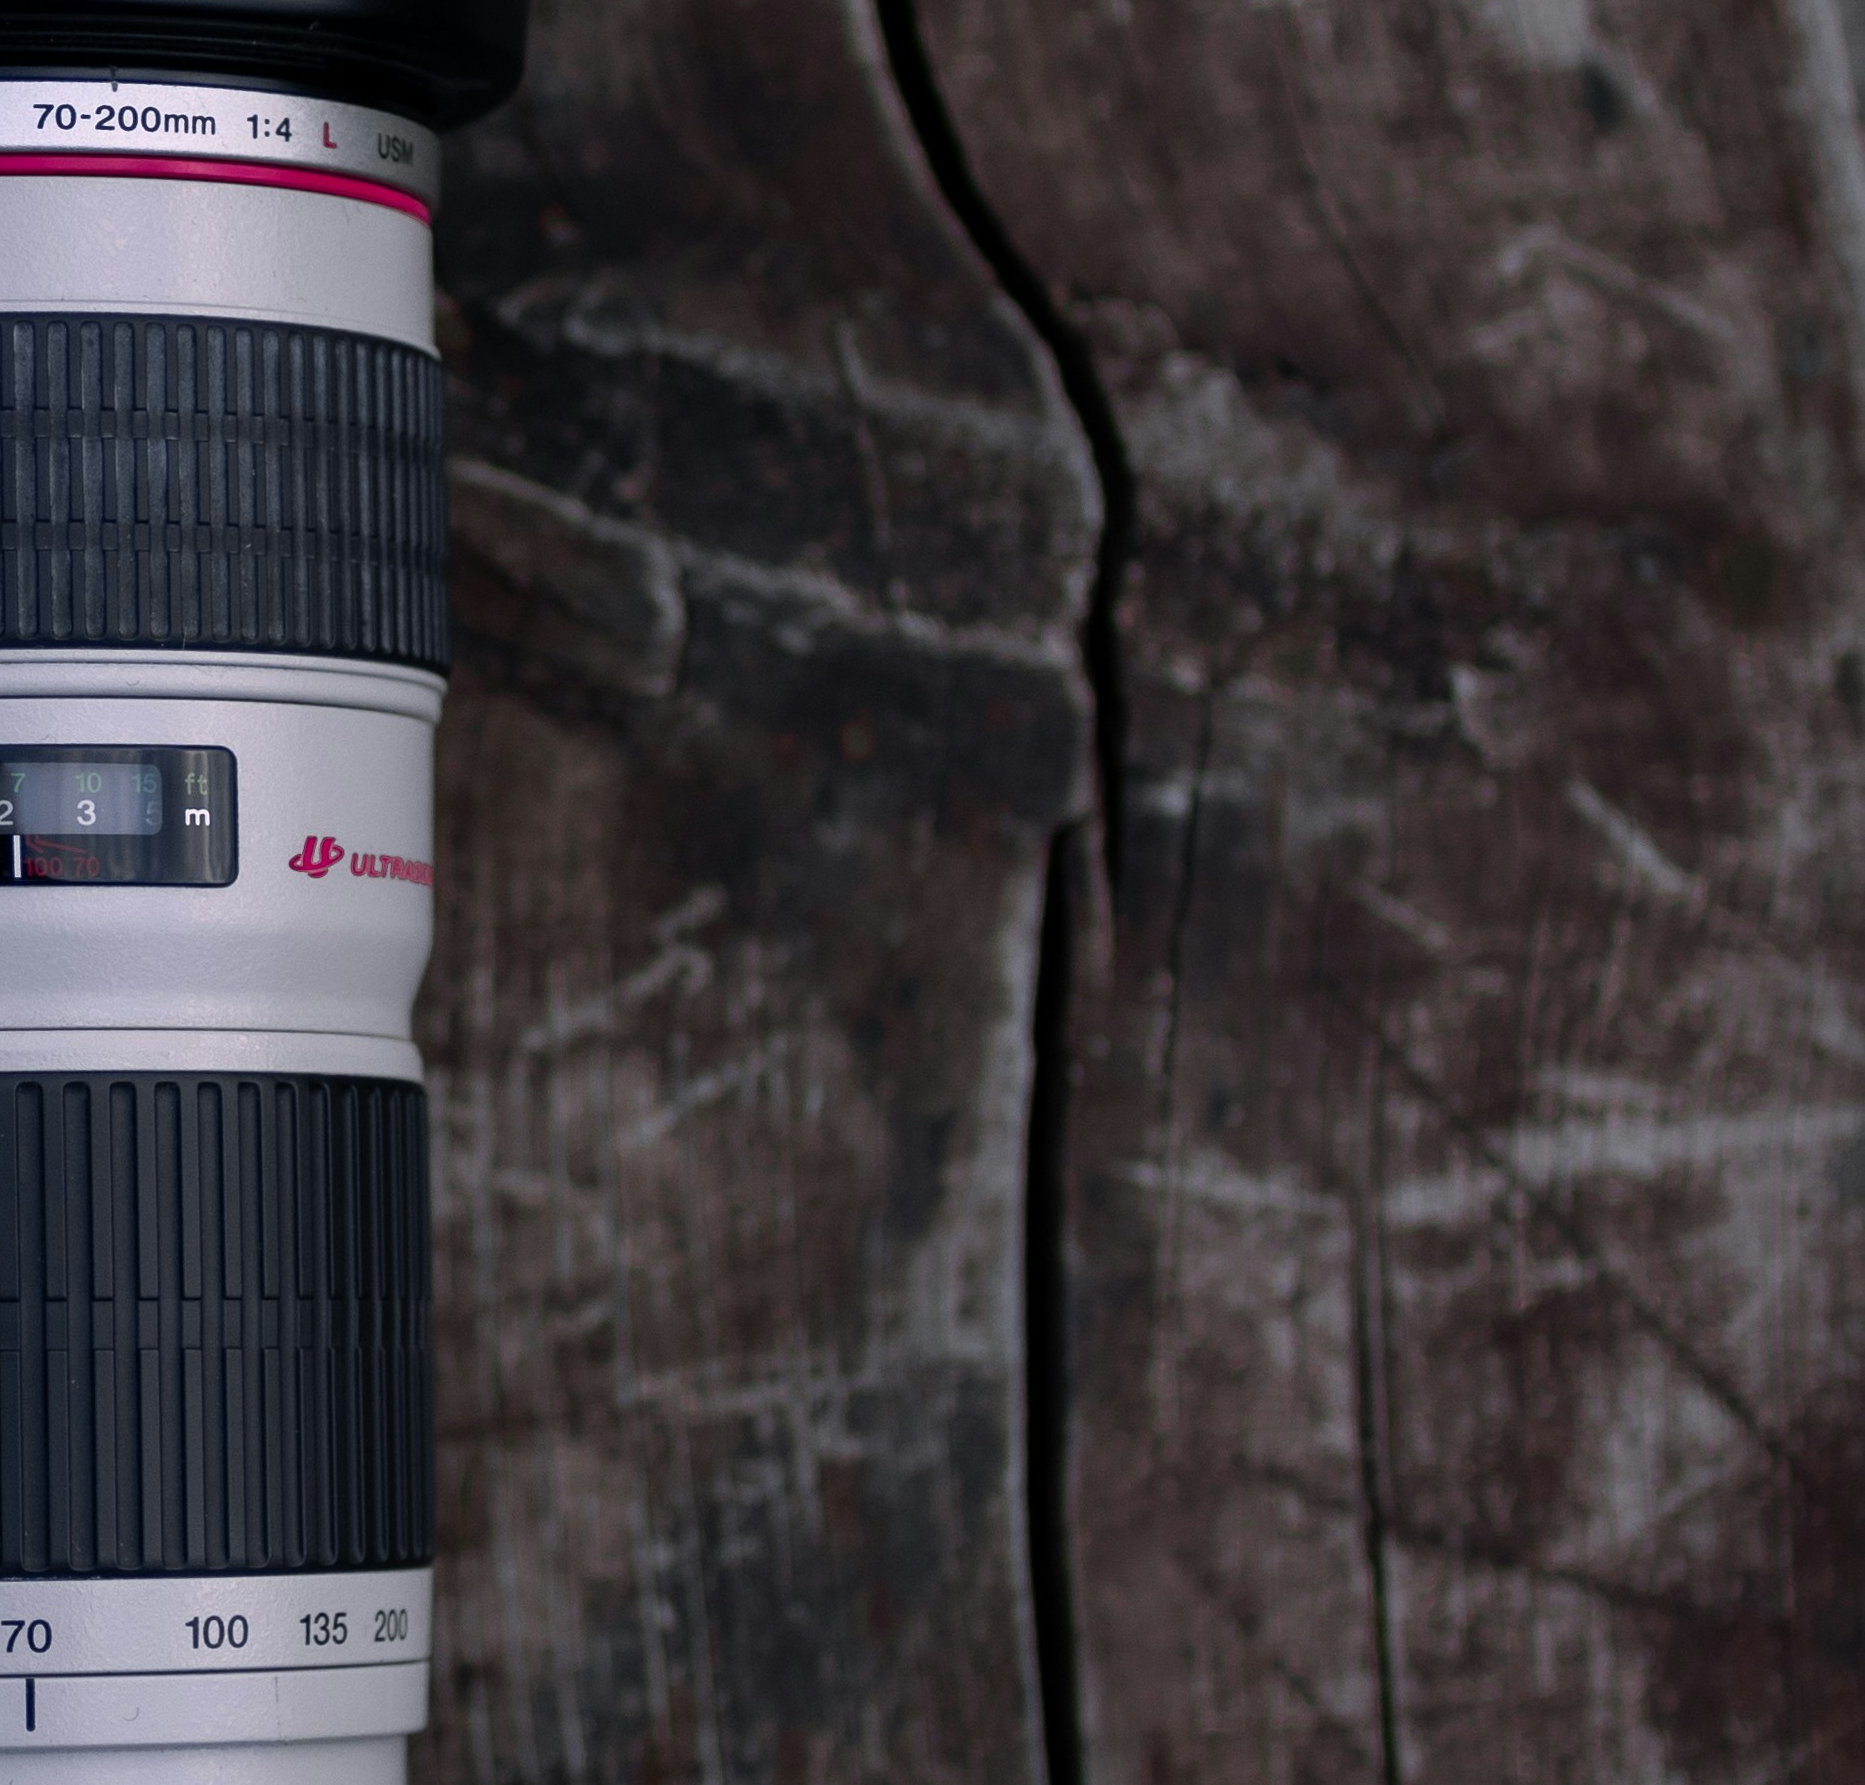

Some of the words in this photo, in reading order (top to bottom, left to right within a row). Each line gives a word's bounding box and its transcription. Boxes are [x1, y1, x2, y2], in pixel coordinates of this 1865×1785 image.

[32, 103, 216, 135] 70-200mm
[246, 114, 293, 143] 1:4
[322, 121, 338, 149] L
[376, 132, 414, 168] USM
[10, 773, 26, 794] 7
[74, 772, 103, 794] 10
[132, 773, 158, 794] 15
[184, 772, 210, 796] ft
[76, 799, 97, 826] 3
[185, 807, 211, 827] m
[24, 856, 64, 877] 100
[74, 856, 101, 877] 70
[0, 1619, 53, 1654] 70
[184, 1614, 249, 1650] 100
[299, 1612, 348, 1647] 135
[373, 1609, 408, 1643] 200
